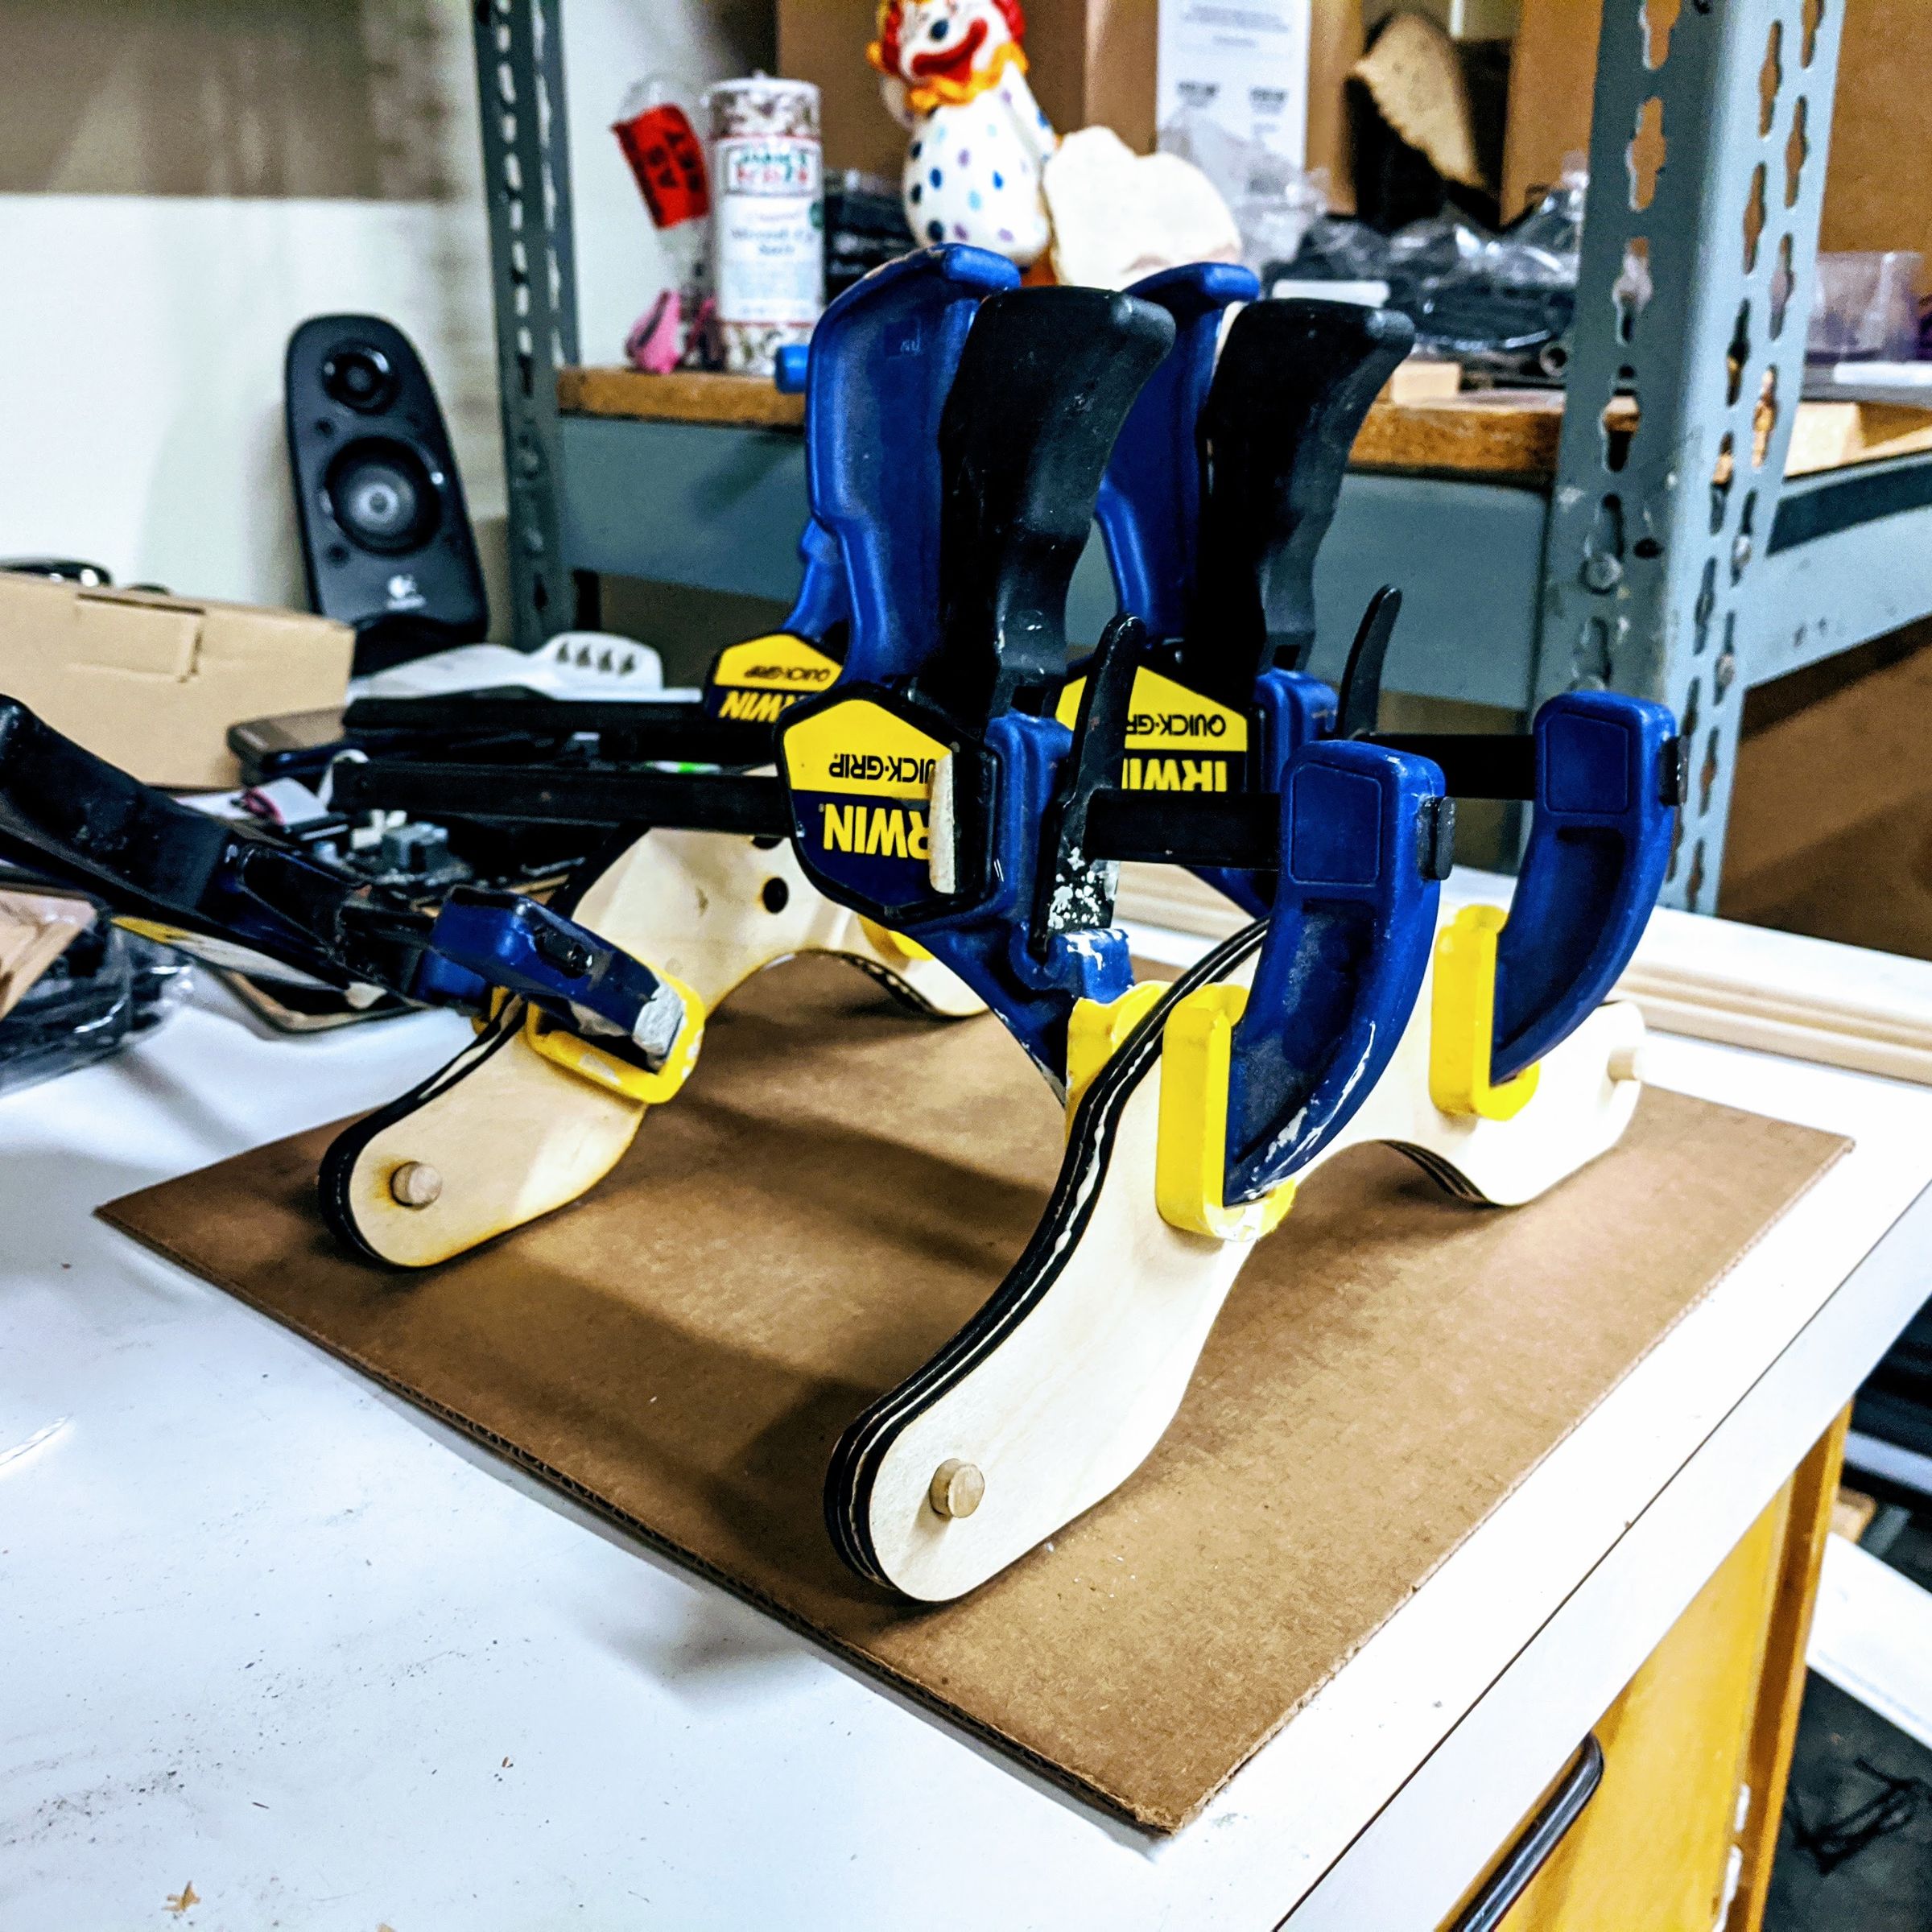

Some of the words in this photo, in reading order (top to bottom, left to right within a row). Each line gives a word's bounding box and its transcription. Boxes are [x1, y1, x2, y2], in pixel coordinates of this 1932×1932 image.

[718, 690, 795, 724] WIN
[1121, 758, 1227, 792] IRWI
[823, 803, 931, 861] RWIN
